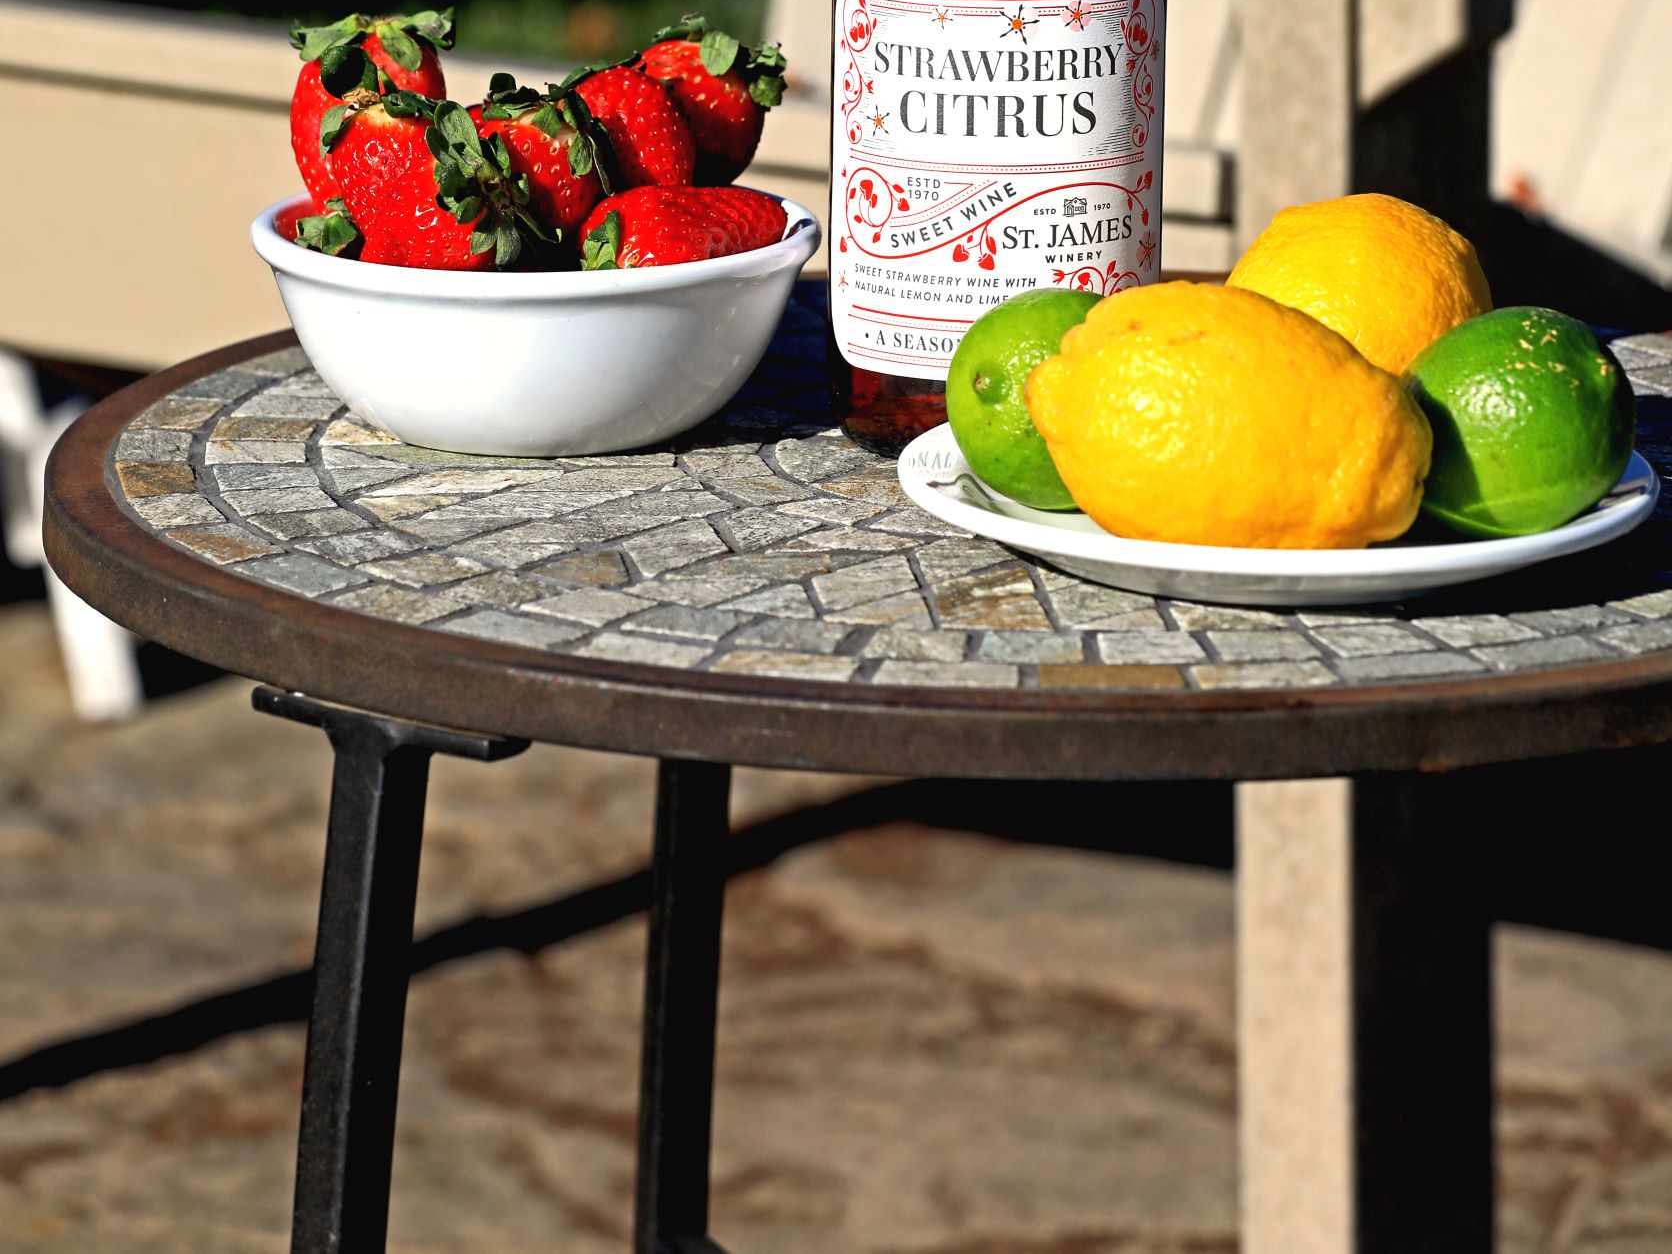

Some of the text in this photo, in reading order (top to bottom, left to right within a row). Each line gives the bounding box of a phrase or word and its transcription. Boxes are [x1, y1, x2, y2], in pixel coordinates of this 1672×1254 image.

[874, 41, 1123, 82] STRAWBERRY
[899, 90, 1097, 138] CITRUS
[907, 176, 941, 189] ESTD
[908, 189, 939, 201] 1970
[890, 182, 1017, 248] SWEET WINE
[1033, 202, 1111, 216] ESTD 1970
[1047, 214, 1132, 248] JAMES
[1045, 250, 1102, 264] WINERY
[854, 263, 1037, 288] SWEET STRAWBERRY WINE WITH
[854, 280, 896, 297] NATURAL
[900, 289, 941, 302] LEMON
[946, 293, 973, 304] AND
[876, 330, 961, 353] A SEASO
